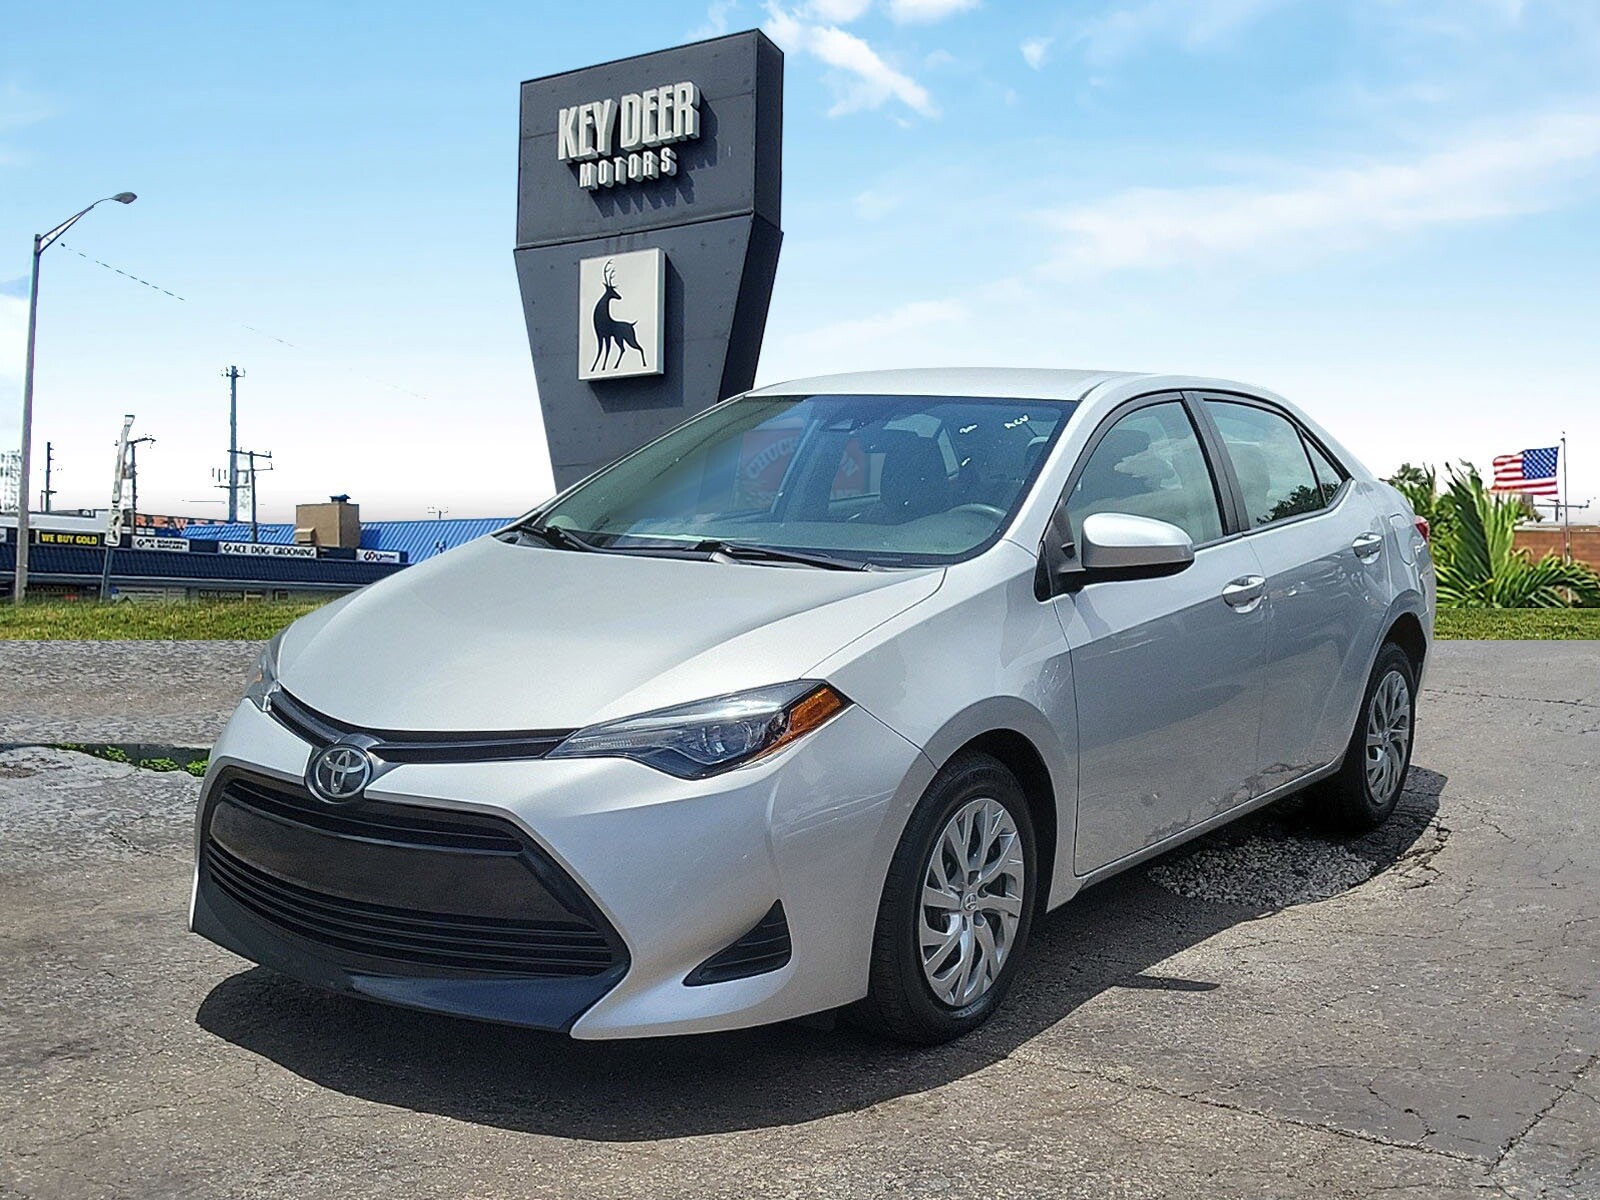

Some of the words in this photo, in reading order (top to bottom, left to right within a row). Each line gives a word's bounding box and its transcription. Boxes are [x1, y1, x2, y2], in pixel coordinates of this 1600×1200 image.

[558, 98, 618, 162] KEY
[620, 81, 701, 152] DEER
[579, 146, 677, 190] MOTORS
[41, 533, 55, 543] WE
[57, 534, 74, 544] BUY
[76, 535, 97, 545] GOLD
[232, 544, 247, 554] ACE
[251, 546, 270, 555] DOG
[273, 547, 315, 557] GROOMING
